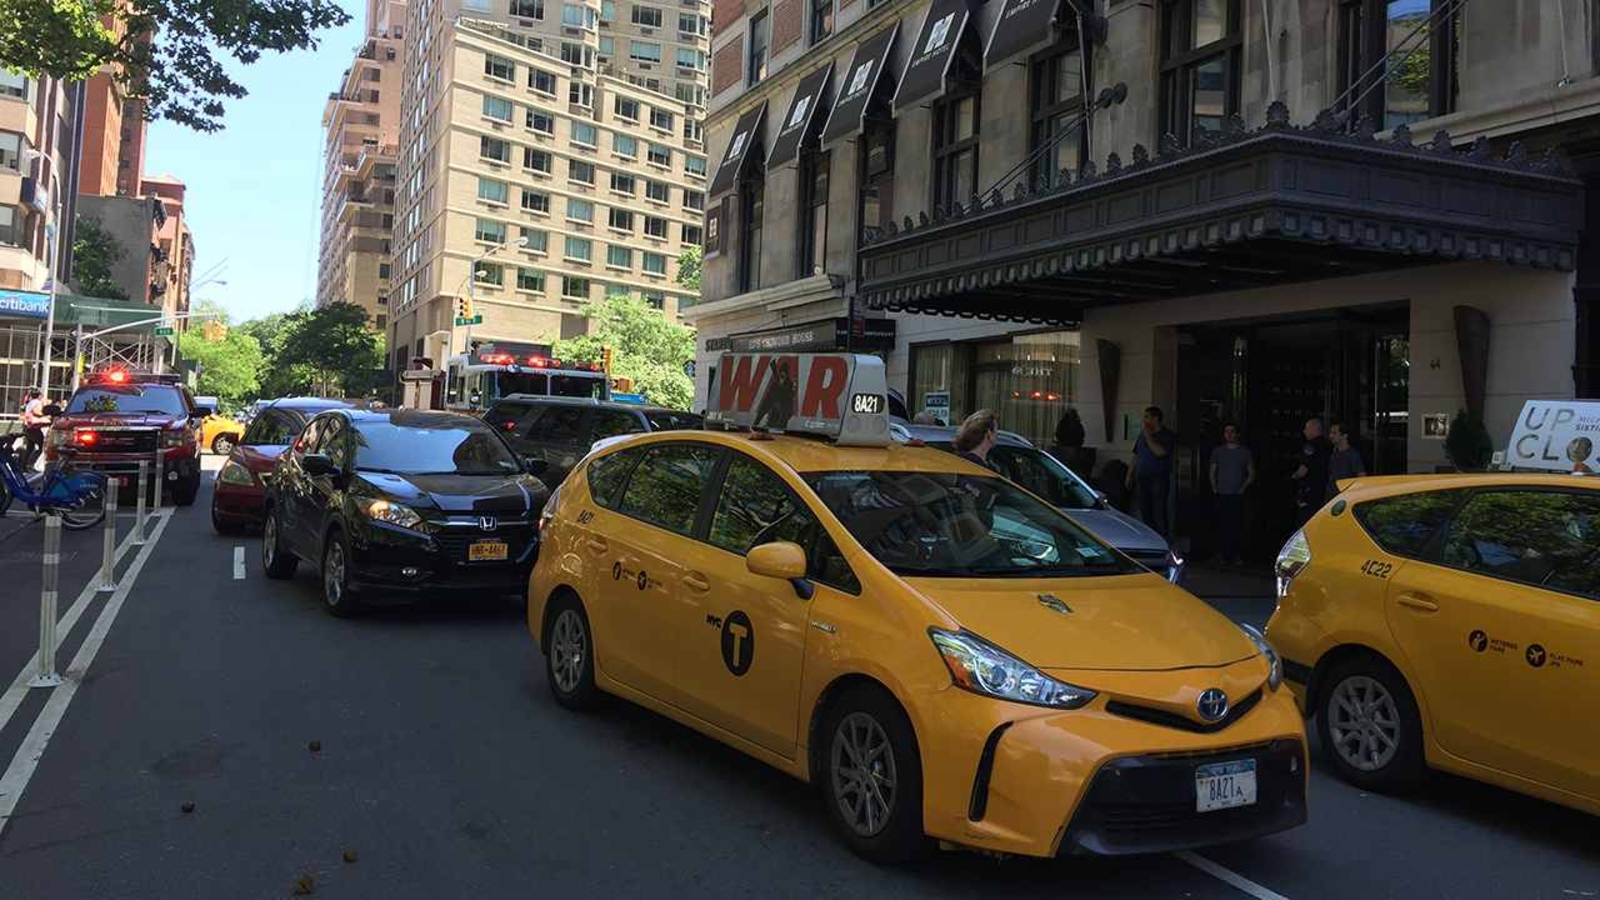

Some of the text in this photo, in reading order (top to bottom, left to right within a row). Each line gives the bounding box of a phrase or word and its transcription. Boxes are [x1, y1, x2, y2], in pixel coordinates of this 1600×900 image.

[0, 297, 50, 312] citibank
[719, 356, 848, 419] WAR
[854, 395, 878, 412] 8A21
[1525, 407, 1575, 430] UP
[1516, 434, 1600, 462] CLO
[1361, 560, 1392, 579] 4C22
[706, 614, 721, 630] NYC
[730, 622, 748, 667] T
